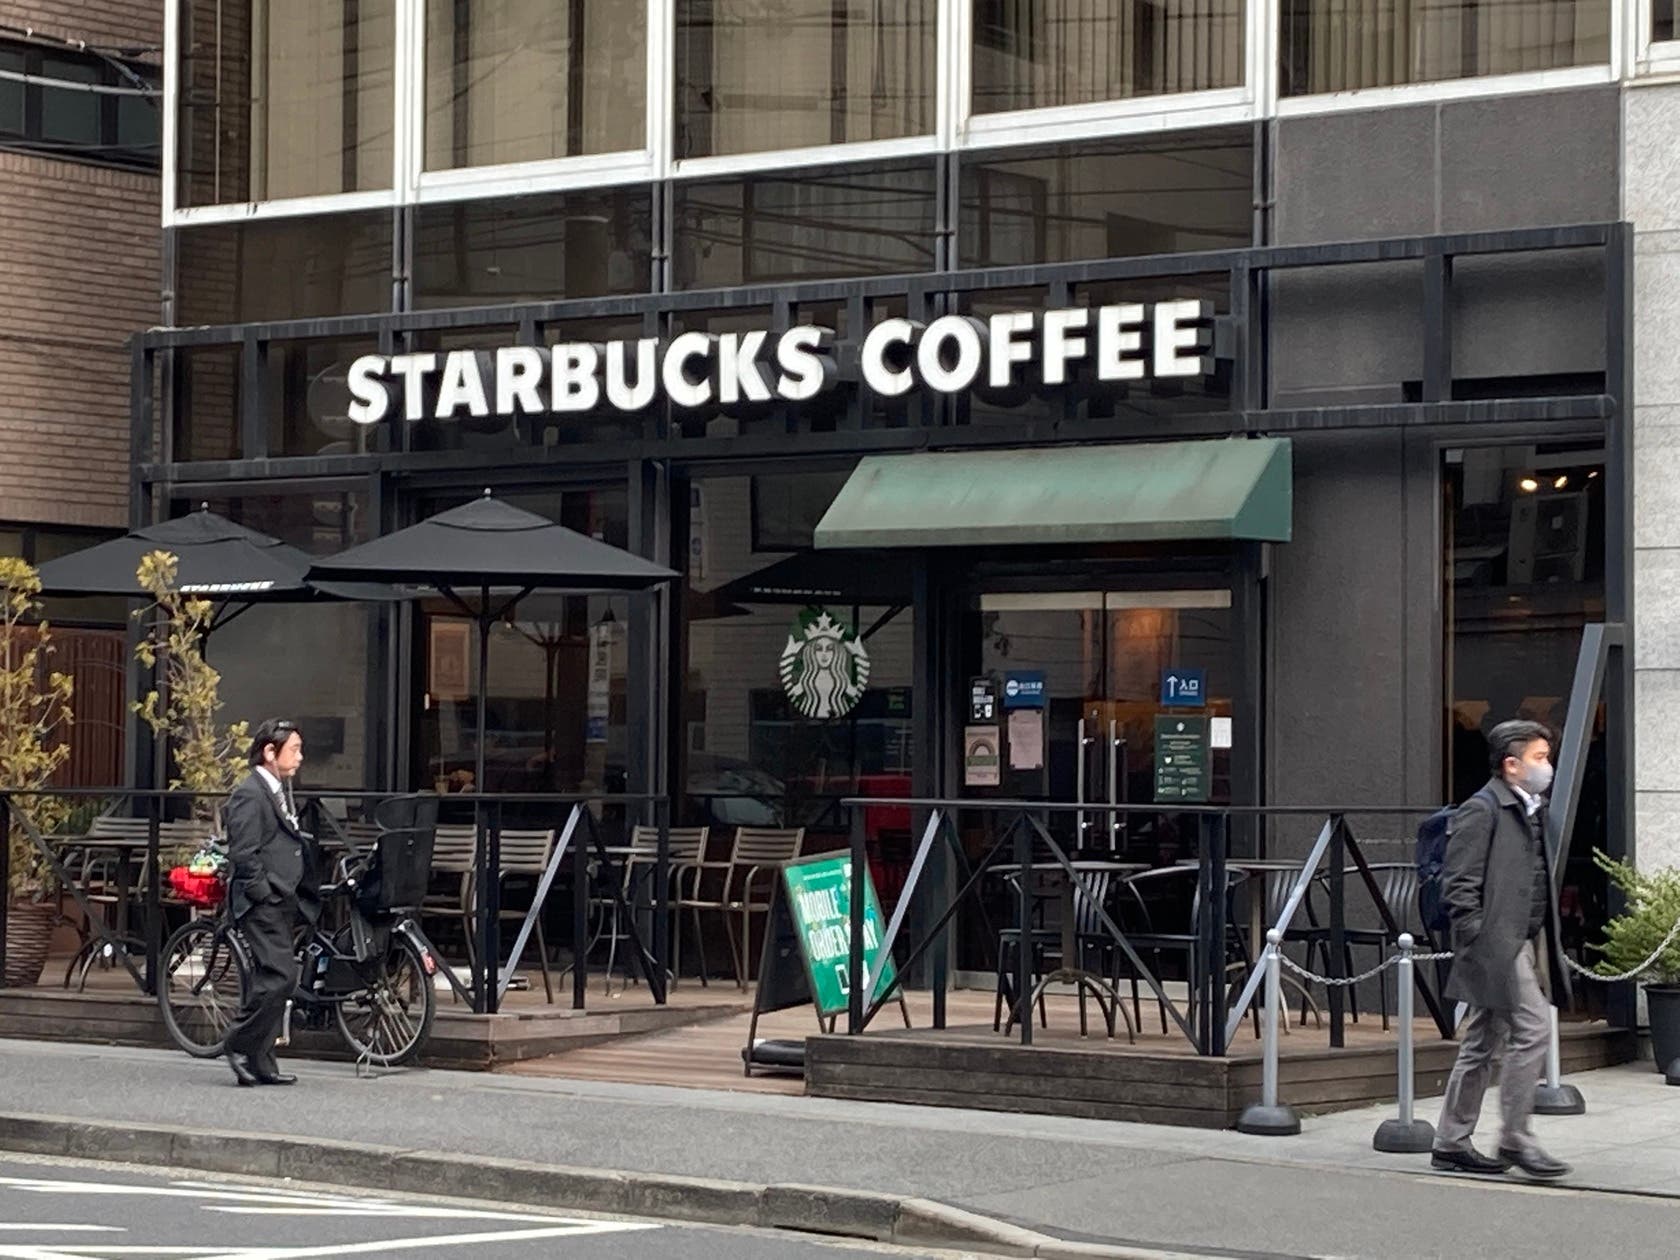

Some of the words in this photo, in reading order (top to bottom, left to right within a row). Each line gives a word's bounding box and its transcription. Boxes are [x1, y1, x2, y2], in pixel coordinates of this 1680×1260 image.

[347, 326, 826, 424] STARBUCKS
[861, 299, 1202, 395] COFFEE
[1179, 679, 1199, 690] 入口
[798, 886, 842, 924] MOBILE
[808, 925, 849, 961] ORDER
